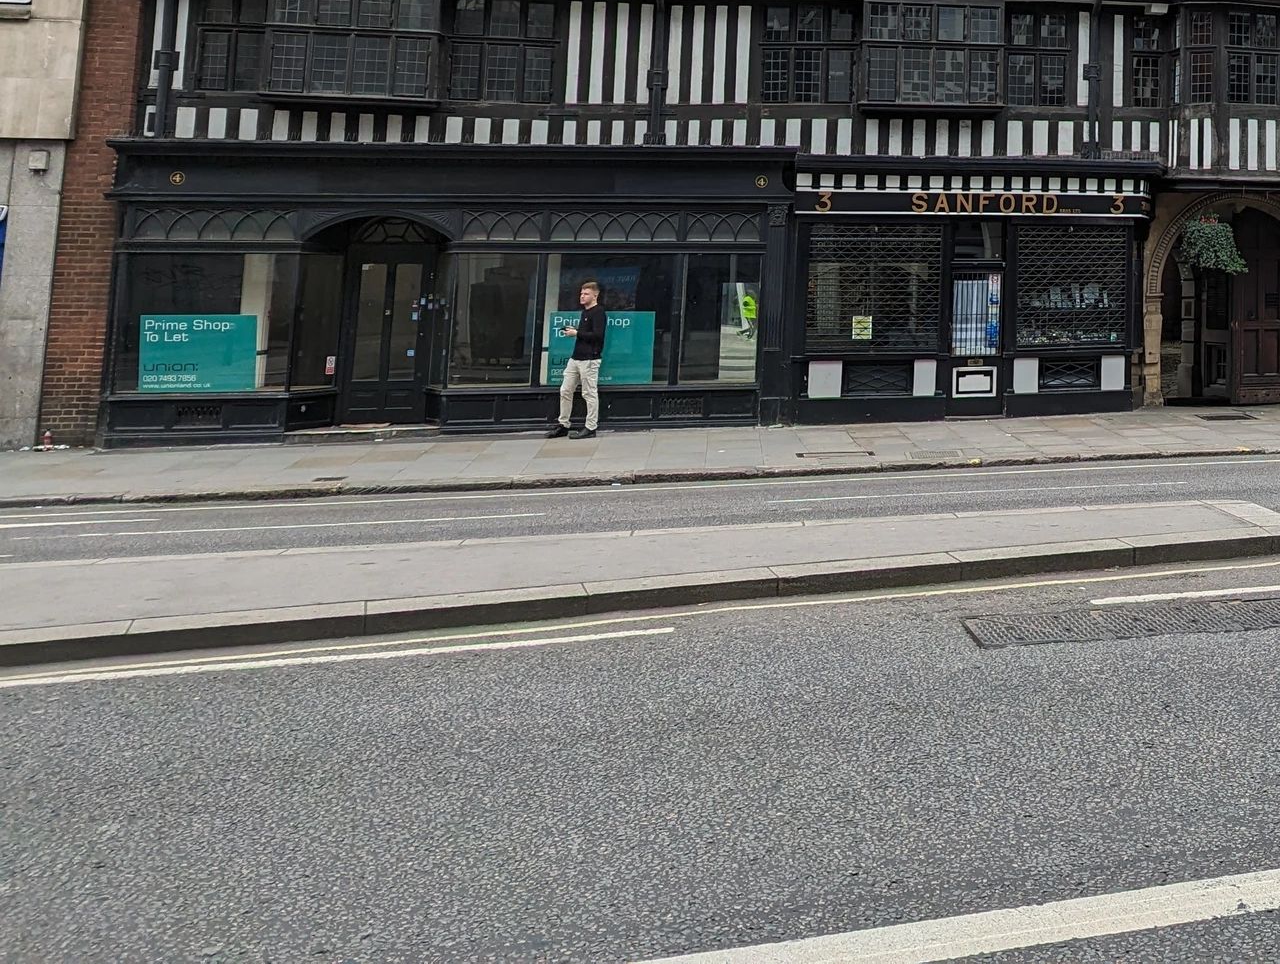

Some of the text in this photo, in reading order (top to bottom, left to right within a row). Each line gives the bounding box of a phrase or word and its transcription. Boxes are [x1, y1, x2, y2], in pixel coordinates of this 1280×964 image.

[815, 191, 832, 212] 3
[911, 193, 1058, 214] SANFORD
[1110, 195, 1124, 214] 3
[144, 319, 230, 332] Prime Shop
[606, 317, 630, 328] hop
[144, 331, 189, 342] To Let
[143, 374, 197, 382] 020 7493 7856
